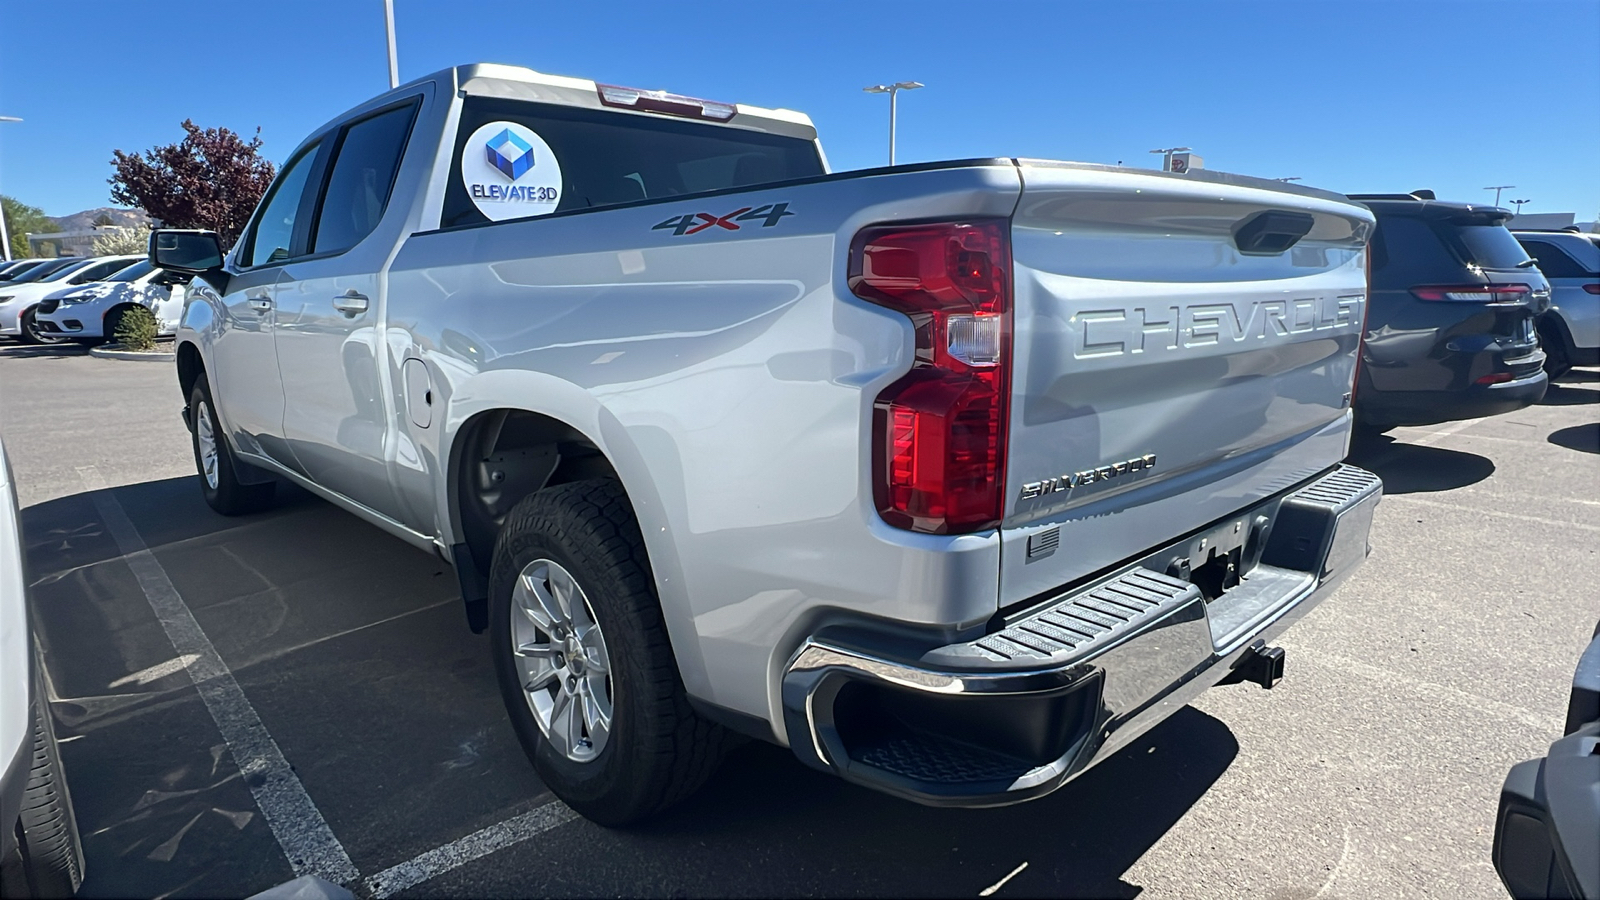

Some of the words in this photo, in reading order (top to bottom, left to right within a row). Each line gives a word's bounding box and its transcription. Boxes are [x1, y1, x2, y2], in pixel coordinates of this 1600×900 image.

[471, 184, 537, 201] ELEVATE
[538, 186, 558, 200] 3D
[1073, 294, 1365, 360] CHEVROLET
[1021, 453, 1157, 500] SILVERADO
